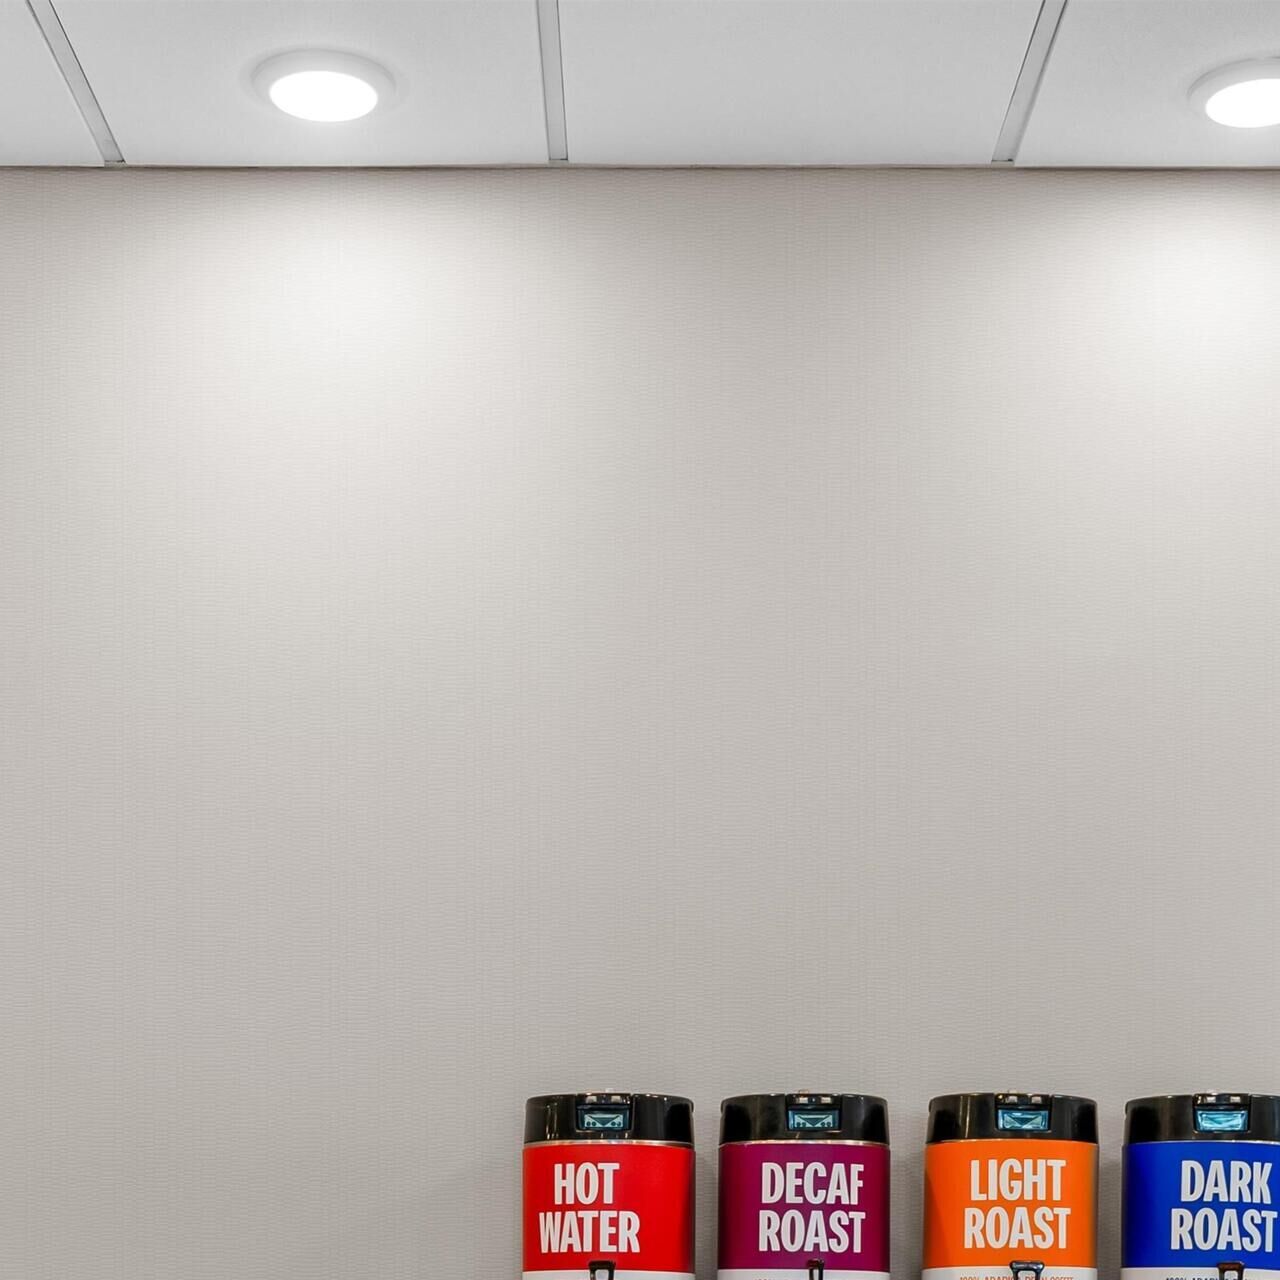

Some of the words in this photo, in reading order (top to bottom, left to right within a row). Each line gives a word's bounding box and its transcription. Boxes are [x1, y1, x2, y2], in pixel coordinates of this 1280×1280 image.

[554, 1162, 620, 1205] HOT
[761, 1162, 865, 1205] DECAF
[970, 1158, 1067, 1201] LIGHT
[1180, 1160, 1273, 1205] DARK
[539, 1210, 641, 1254] WATER
[758, 1209, 866, 1254] ROAST
[963, 1206, 1072, 1249] ROAST
[1170, 1207, 1278, 1253] ROAST
